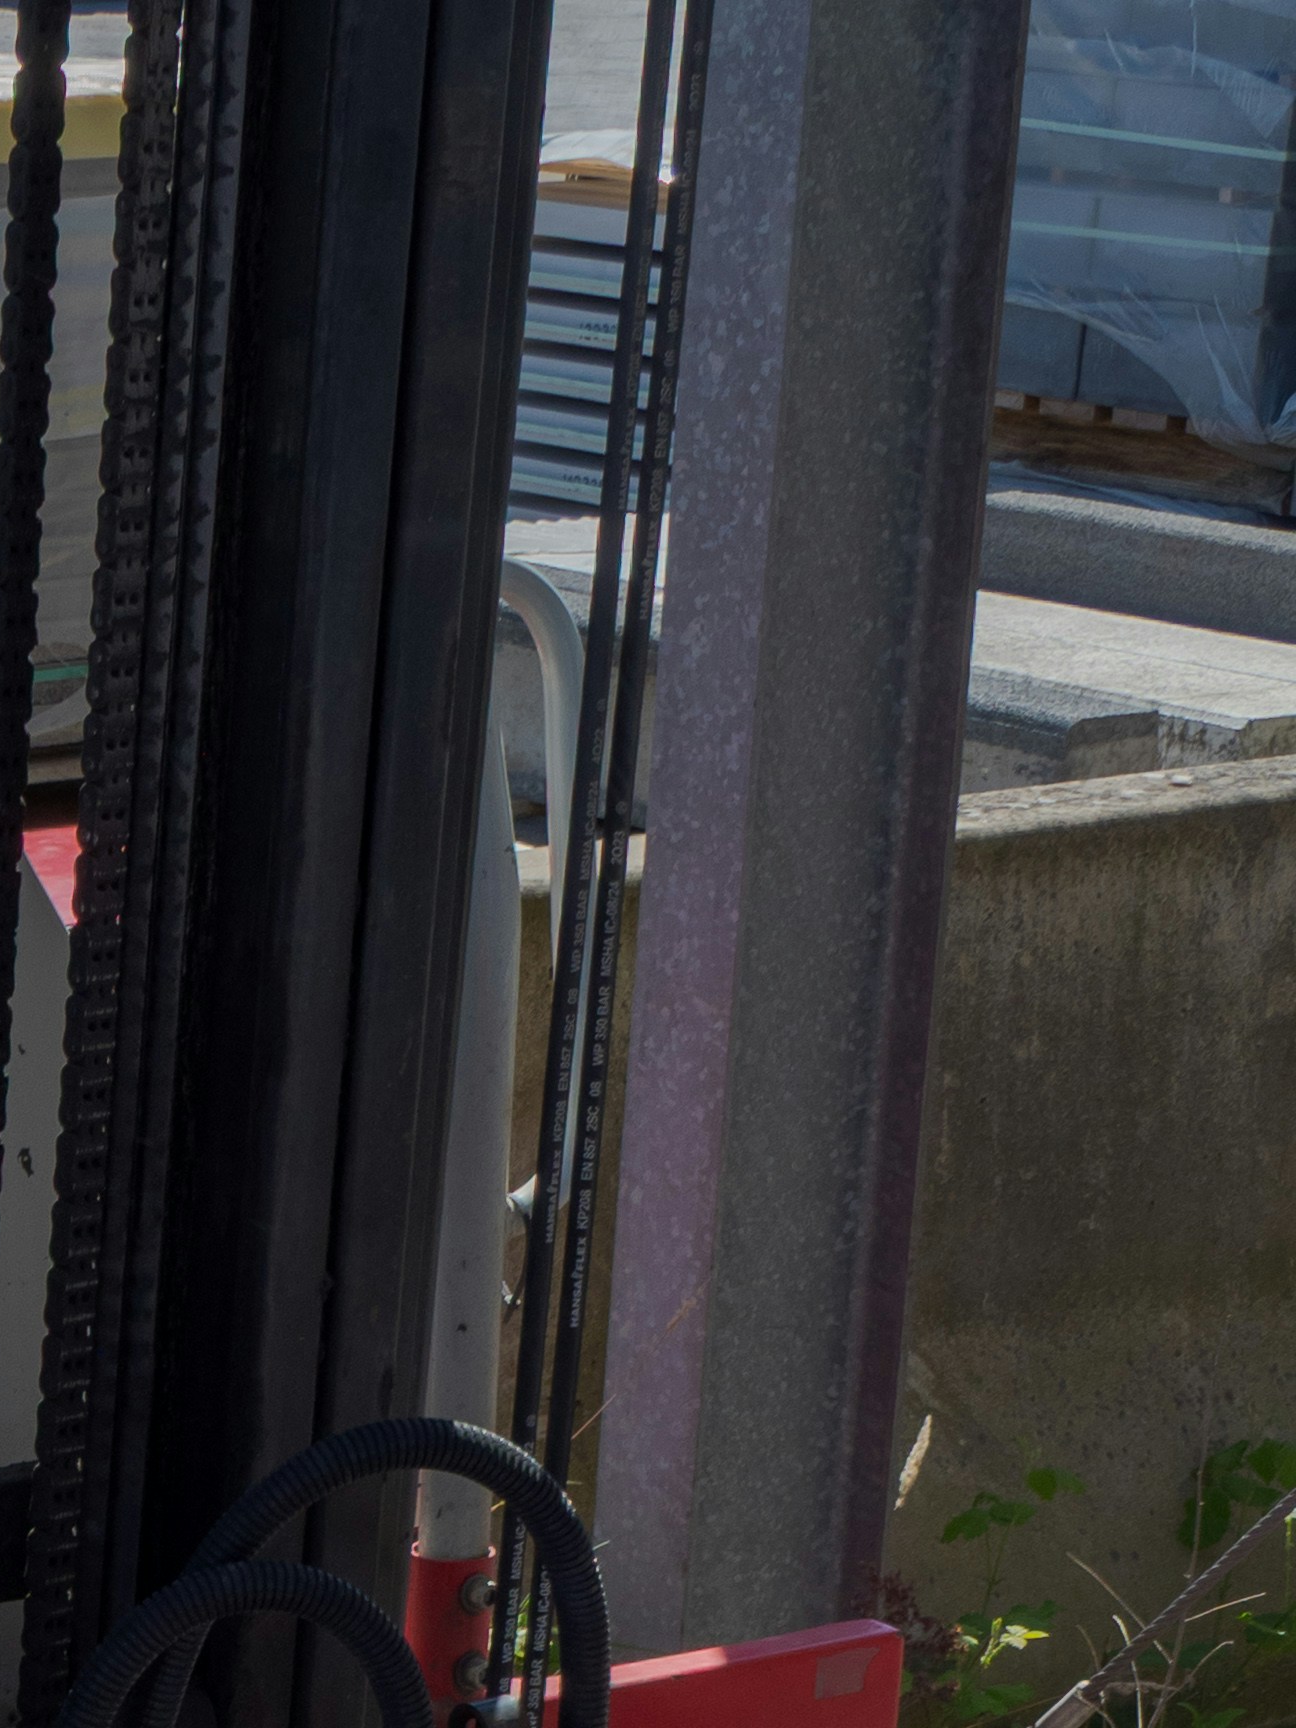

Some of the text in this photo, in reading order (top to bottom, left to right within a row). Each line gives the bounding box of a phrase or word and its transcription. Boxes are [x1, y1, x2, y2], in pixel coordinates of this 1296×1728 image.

[578, 837, 593, 881] MSHA
[609, 829, 625, 865] 2Q23
[574, 887, 589, 921] BAR
[572, 921, 585, 946] 350
[569, 947, 583, 974] WP
[599, 933, 615, 977] MSHA
[596, 984, 611, 1016] BAR
[593, 1017, 608, 1041] 350
[591, 1041, 606, 1067] WP
[556, 1070, 570, 1092] EN
[584, 1104, 600, 1133] 2SC
[582, 1136, 597, 1160] 857
[580, 1160, 594, 1181] EN
[575, 1187, 592, 1230] KP208
[509, 1538, 525, 1581] MSHA
[505, 1586, 520, 1617] BAR
[503, 1616, 516, 1640] 350
[532, 1613, 549, 1652] MSHA
[500, 1641, 514, 1664] WP
[529, 1656, 544, 1687] BAR
[526, 1687, 541, 1709] 350
